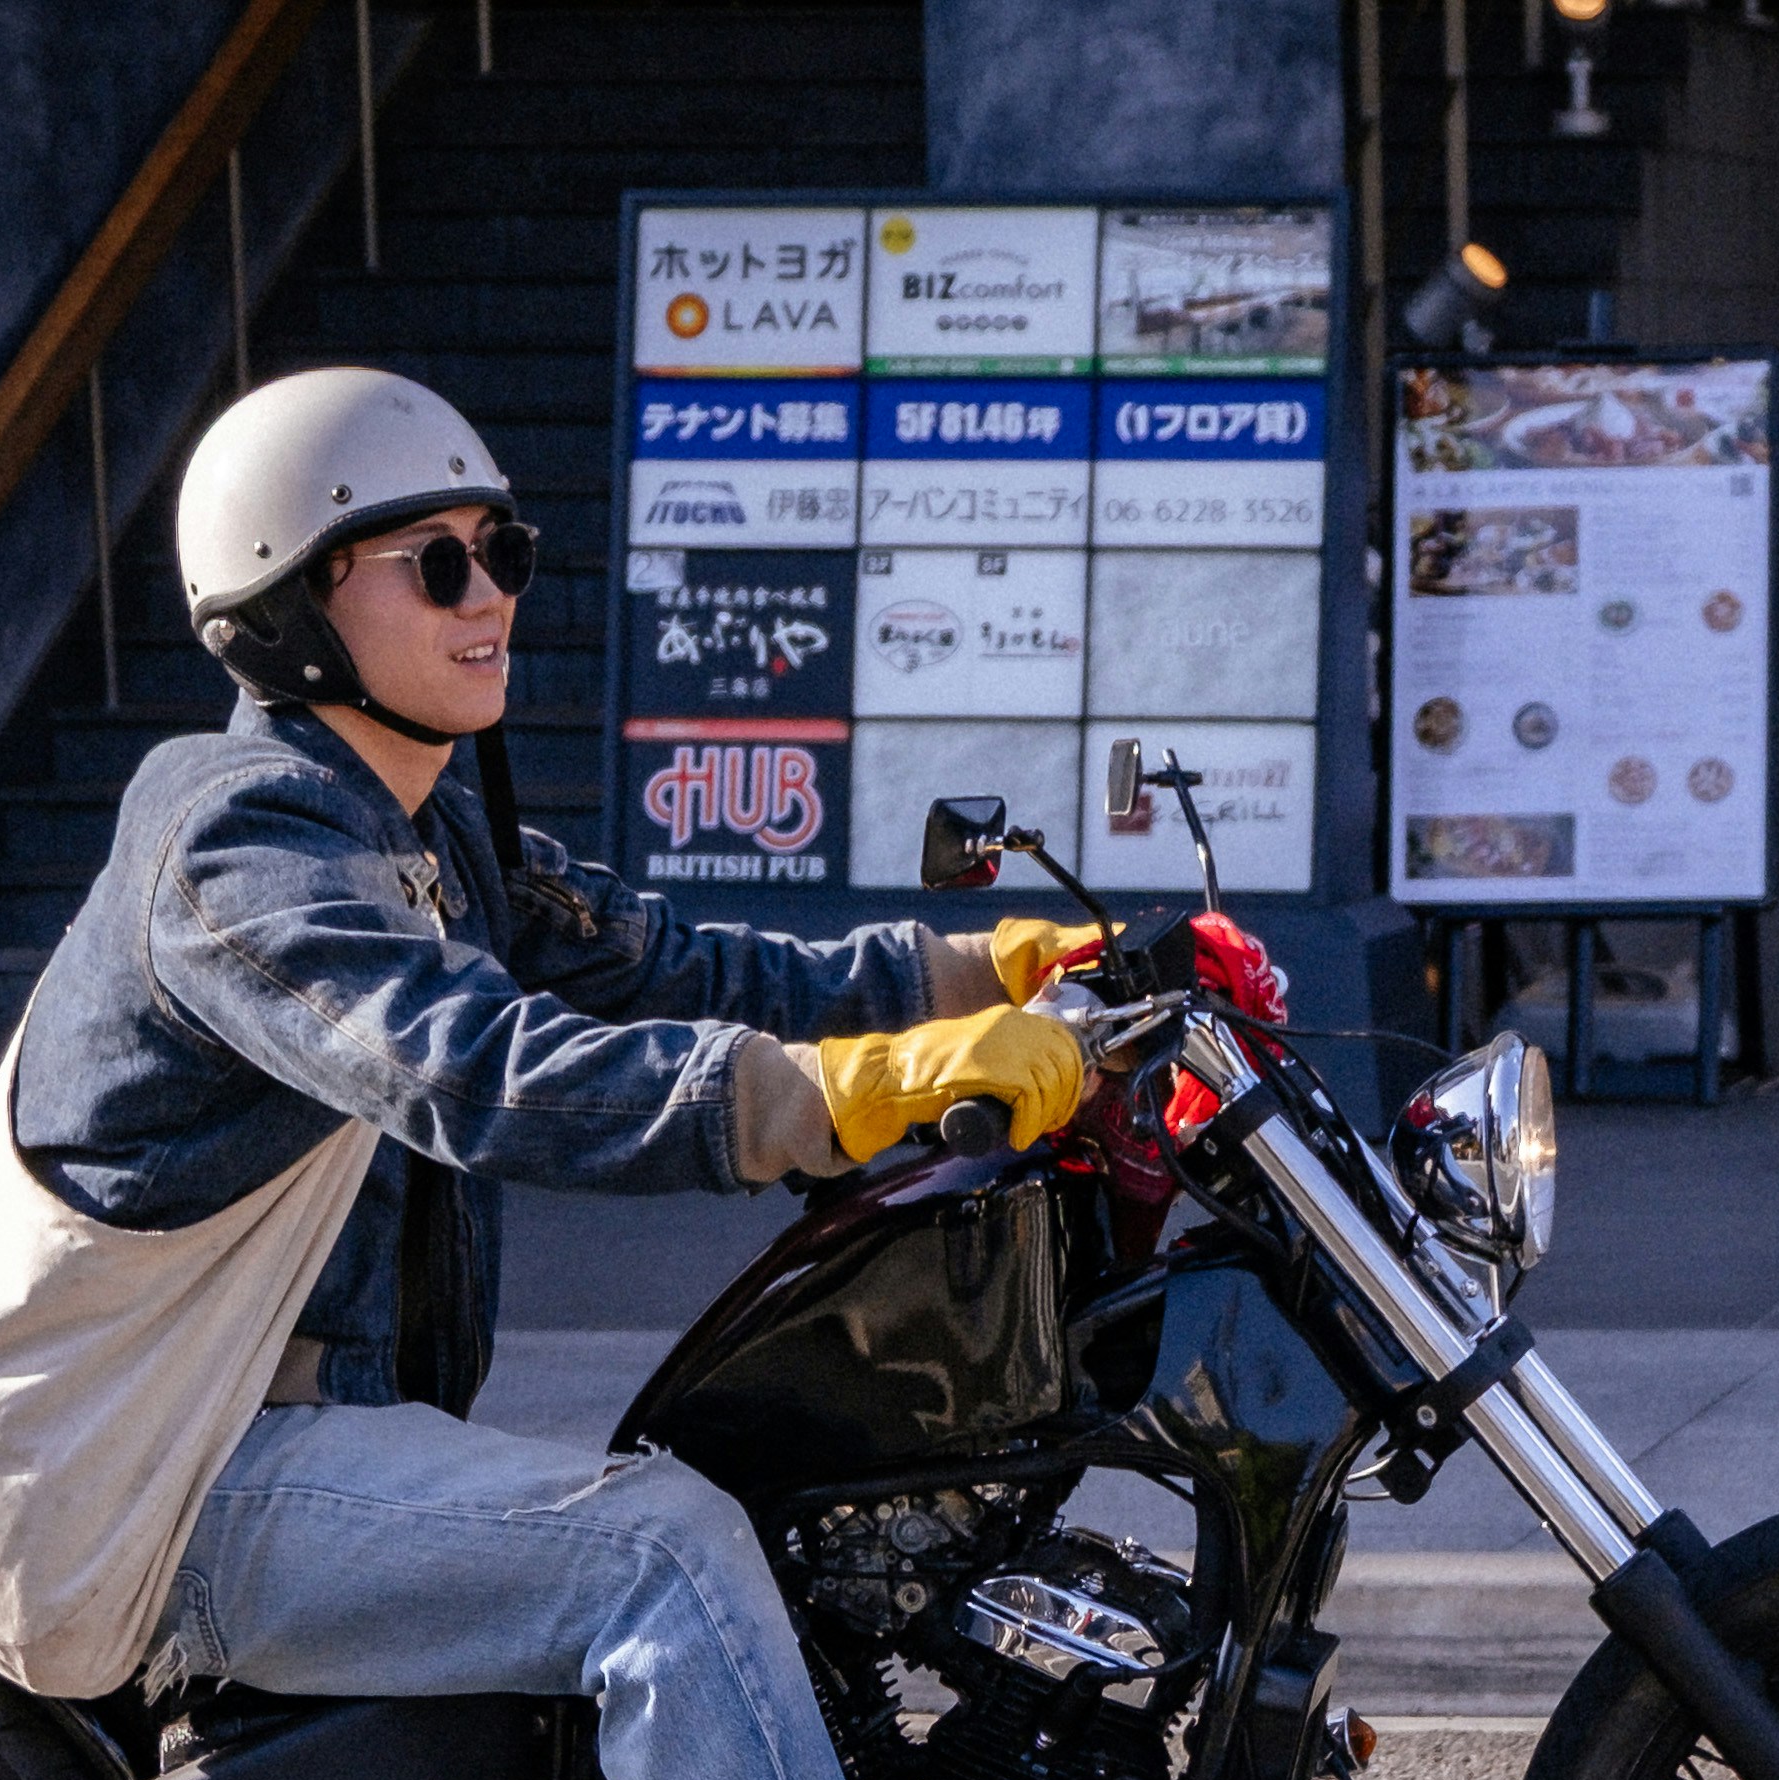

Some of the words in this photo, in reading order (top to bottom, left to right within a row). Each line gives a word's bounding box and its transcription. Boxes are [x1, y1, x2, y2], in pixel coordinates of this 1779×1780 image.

[650, 237, 858, 280] ホットヨガ
[723, 300, 839, 331] LAVA
[643, 746, 824, 855] HUB
[647, 854, 763, 880] BRITISH
[767, 855, 826, 880] PUB
